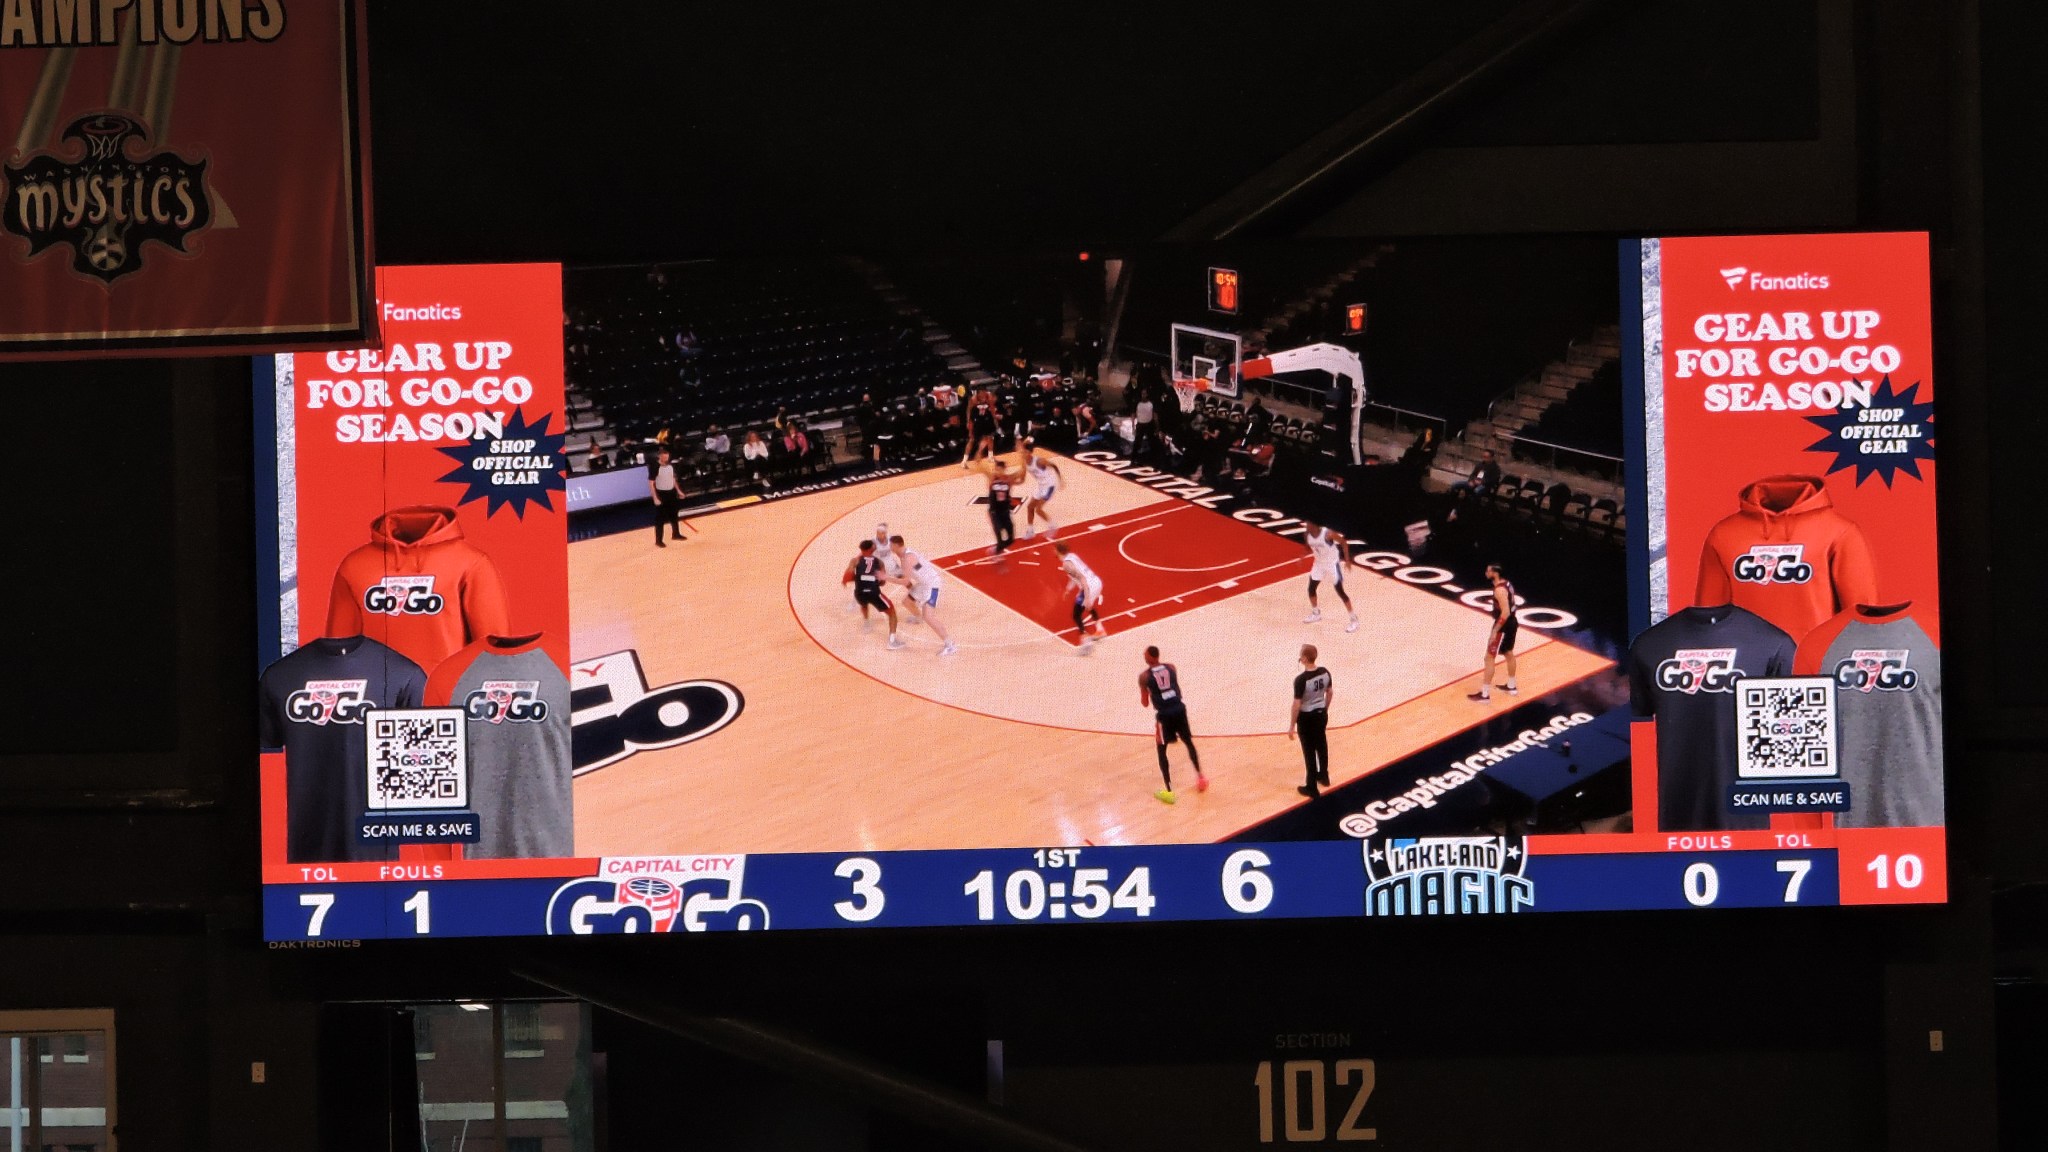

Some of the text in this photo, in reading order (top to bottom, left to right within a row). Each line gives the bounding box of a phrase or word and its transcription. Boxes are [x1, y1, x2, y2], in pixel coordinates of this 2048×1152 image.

[24, 164, 186, 182] WASHINGTON
[1750, 272, 1830, 291] Fanatics
[383, 304, 462, 321] Fanatics
[1694, 310, 1880, 342] GEAR UP
[326, 341, 512, 373] GEAR UP
[1675, 345, 1901, 378] FOR GO-GO
[307, 376, 532, 409] FOR GO-GO
[1704, 380, 1873, 412] SEASON
[336, 411, 505, 443] SEASON
[1858, 408, 1904, 423] SHOP
[489, 440, 536, 454] SHOP
[1840, 424, 1922, 440] OFFICIAL
[1859, 440, 1908, 455] GEAR
[472, 456, 553, 471] OFFICIAL
[491, 471, 539, 486] GEAR
[1073, 451, 1233, 509] CAPITAL
[1733, 791, 1843, 807] SCAN ME & SAVE
[362, 823, 472, 838] SCAN ME & SAVE
[1667, 834, 1812, 850] FOULS TOL
[301, 865, 443, 881] TOL FOULS
[607, 858, 735, 874] CAPITAL CITY
[1034, 849, 1081, 868] 1ST
[1393, 843, 1498, 873] LAKELAND
[1867, 854, 1923, 889] 10
[833, 857, 885, 922] 3
[964, 867, 1156, 920] 10:54
[1221, 849, 1274, 914] 6
[1366, 868, 1535, 916] MAGIC
[1683, 862, 1719, 907] 0
[1776, 859, 1812, 903] 7
[299, 894, 335, 936] 7
[404, 890, 430, 934] 1
[268, 940, 361, 950] DAKTRONICS
[1275, 1033, 1351, 1049] SECTION
[1254, 1058, 1377, 1142] 102
